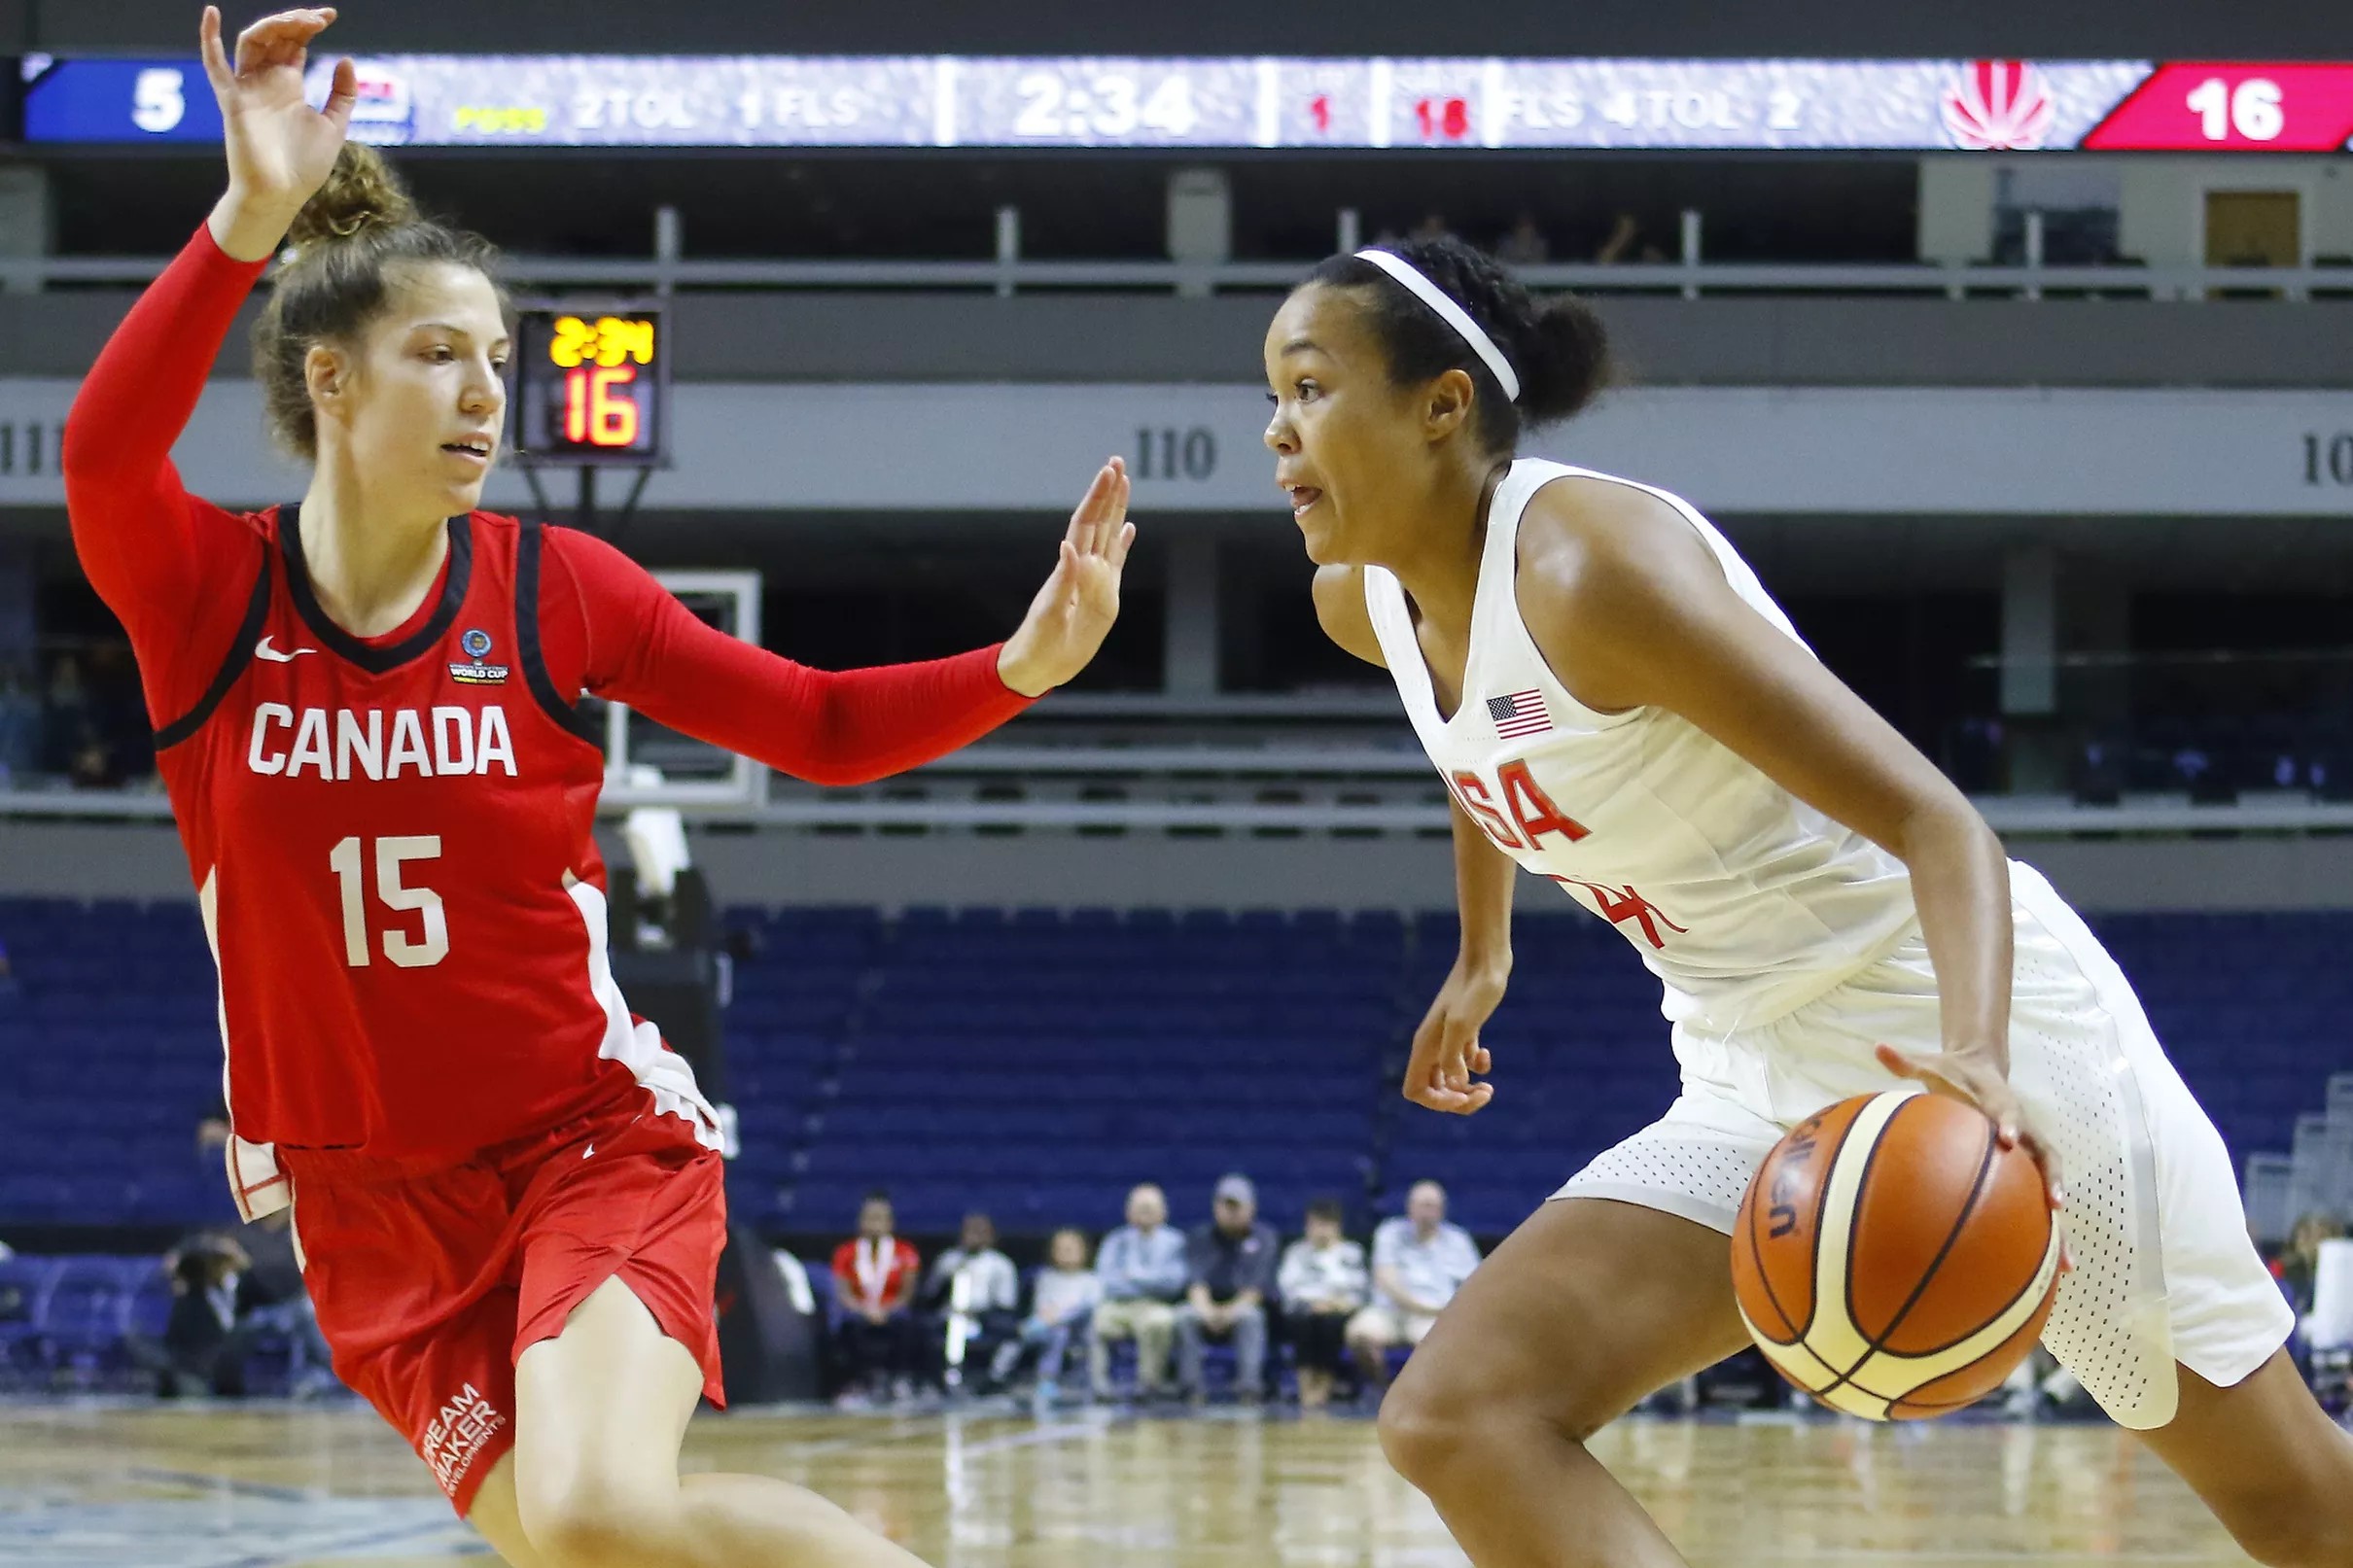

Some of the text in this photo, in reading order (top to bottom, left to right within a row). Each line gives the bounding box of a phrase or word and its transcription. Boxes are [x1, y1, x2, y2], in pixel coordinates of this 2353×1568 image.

[132, 69, 186, 133] 5
[775, 89, 861, 128] FLS
[1014, 76, 1198, 138] 2:34
[1310, 93, 1331, 132] 1
[2186, 77, 2284, 141] 16
[564, 364, 640, 447] 16
[1137, 428, 1217, 480] 110
[450, 668, 509, 679] WORLD CUP
[248, 702, 518, 782] CANADA
[1441, 757, 1593, 852] SA
[330, 835, 450, 967] 15
